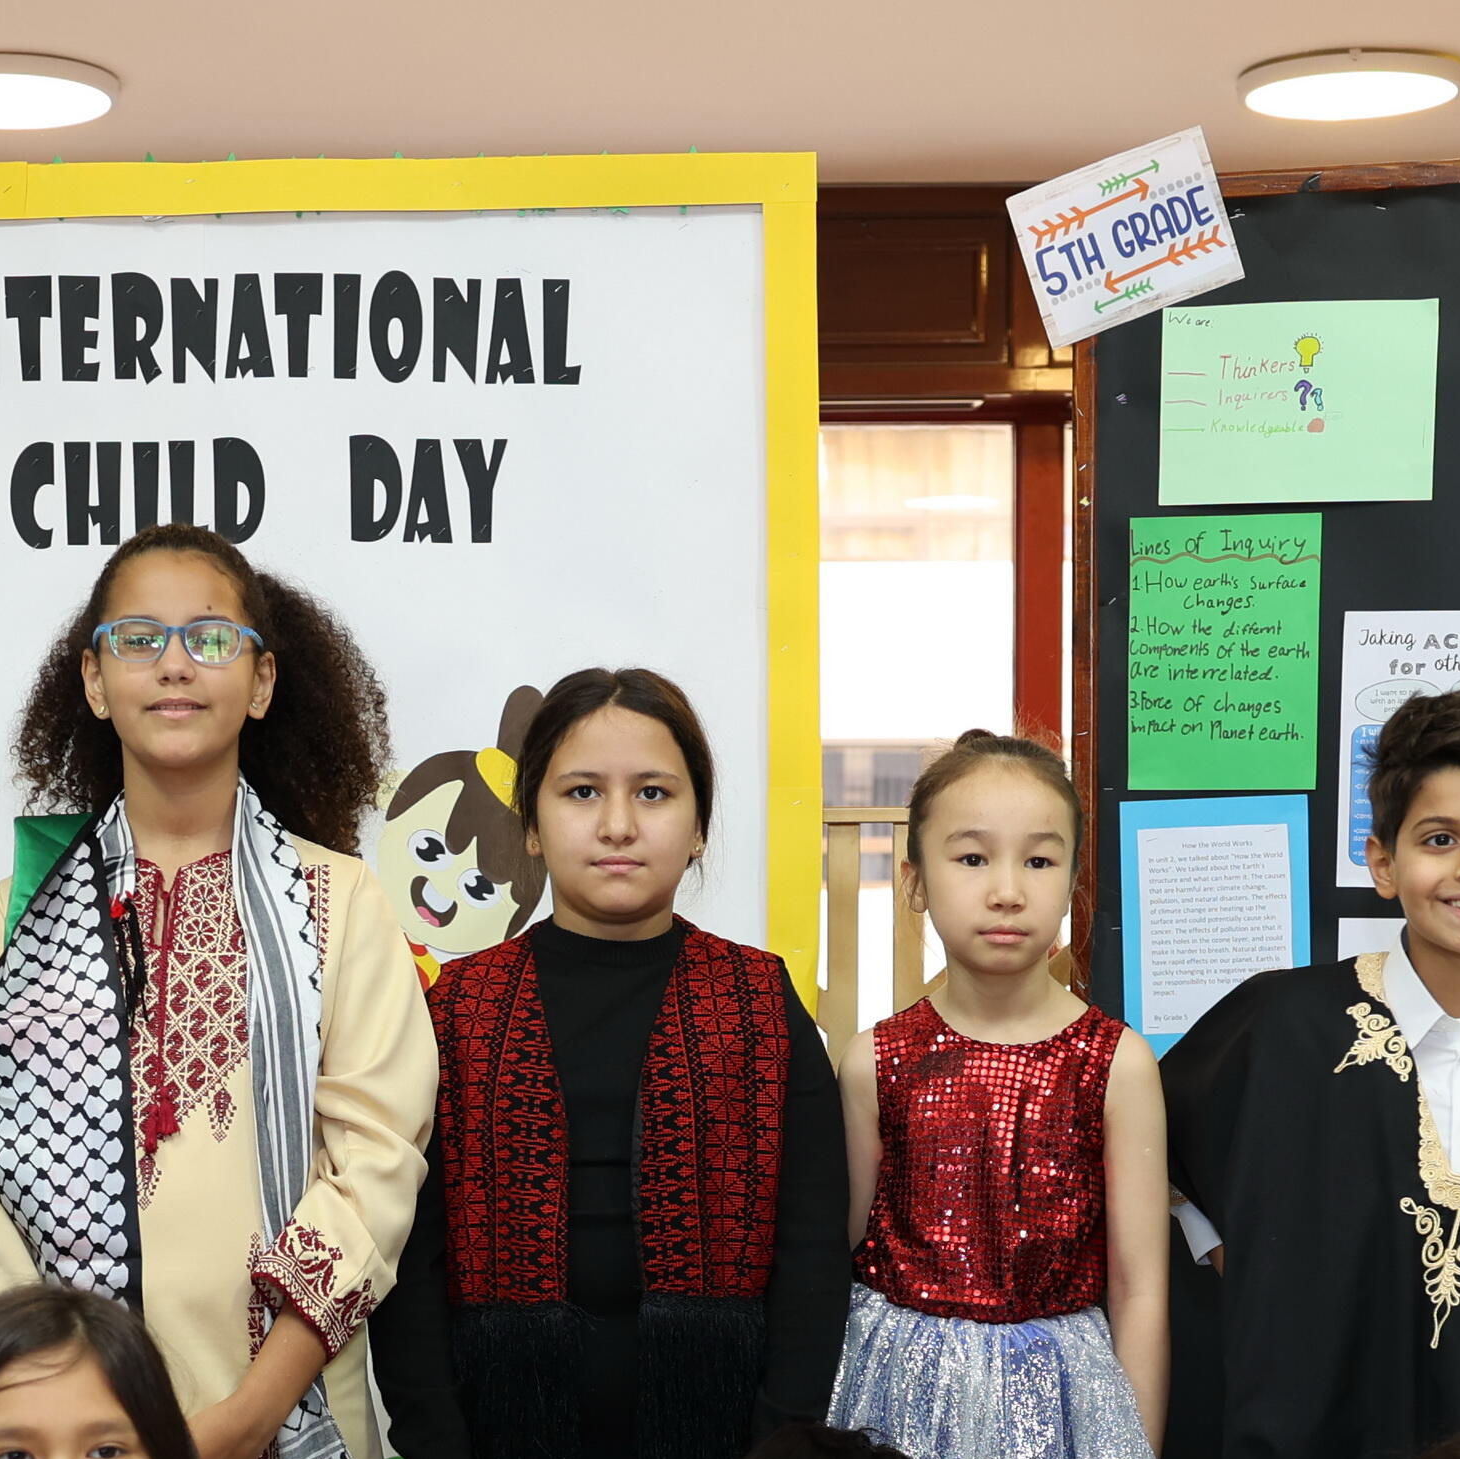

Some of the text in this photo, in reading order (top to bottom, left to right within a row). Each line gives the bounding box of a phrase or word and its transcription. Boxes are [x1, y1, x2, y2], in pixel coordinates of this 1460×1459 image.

[1035, 185, 1214, 296] 5TH GRADE
[1168, 310, 1192, 326] We
[1218, 388, 1288, 411] Inquirers
[9, 434, 509, 554] CHILD DAY
[1130, 529, 1307, 565] Lines of Inquiry
[1191, 618, 1213, 637] the
[1239, 639, 1261, 658] the
[1267, 640, 1310, 660] earth
[1358, 628, 1417, 651] Taking
[1167, 662, 1280, 682] interrelated.
[1389, 658, 1426, 676] for
[1213, 692, 1282, 719] changes
[1180, 721, 1204, 736] on
[1258, 722, 1306, 742] earth.
